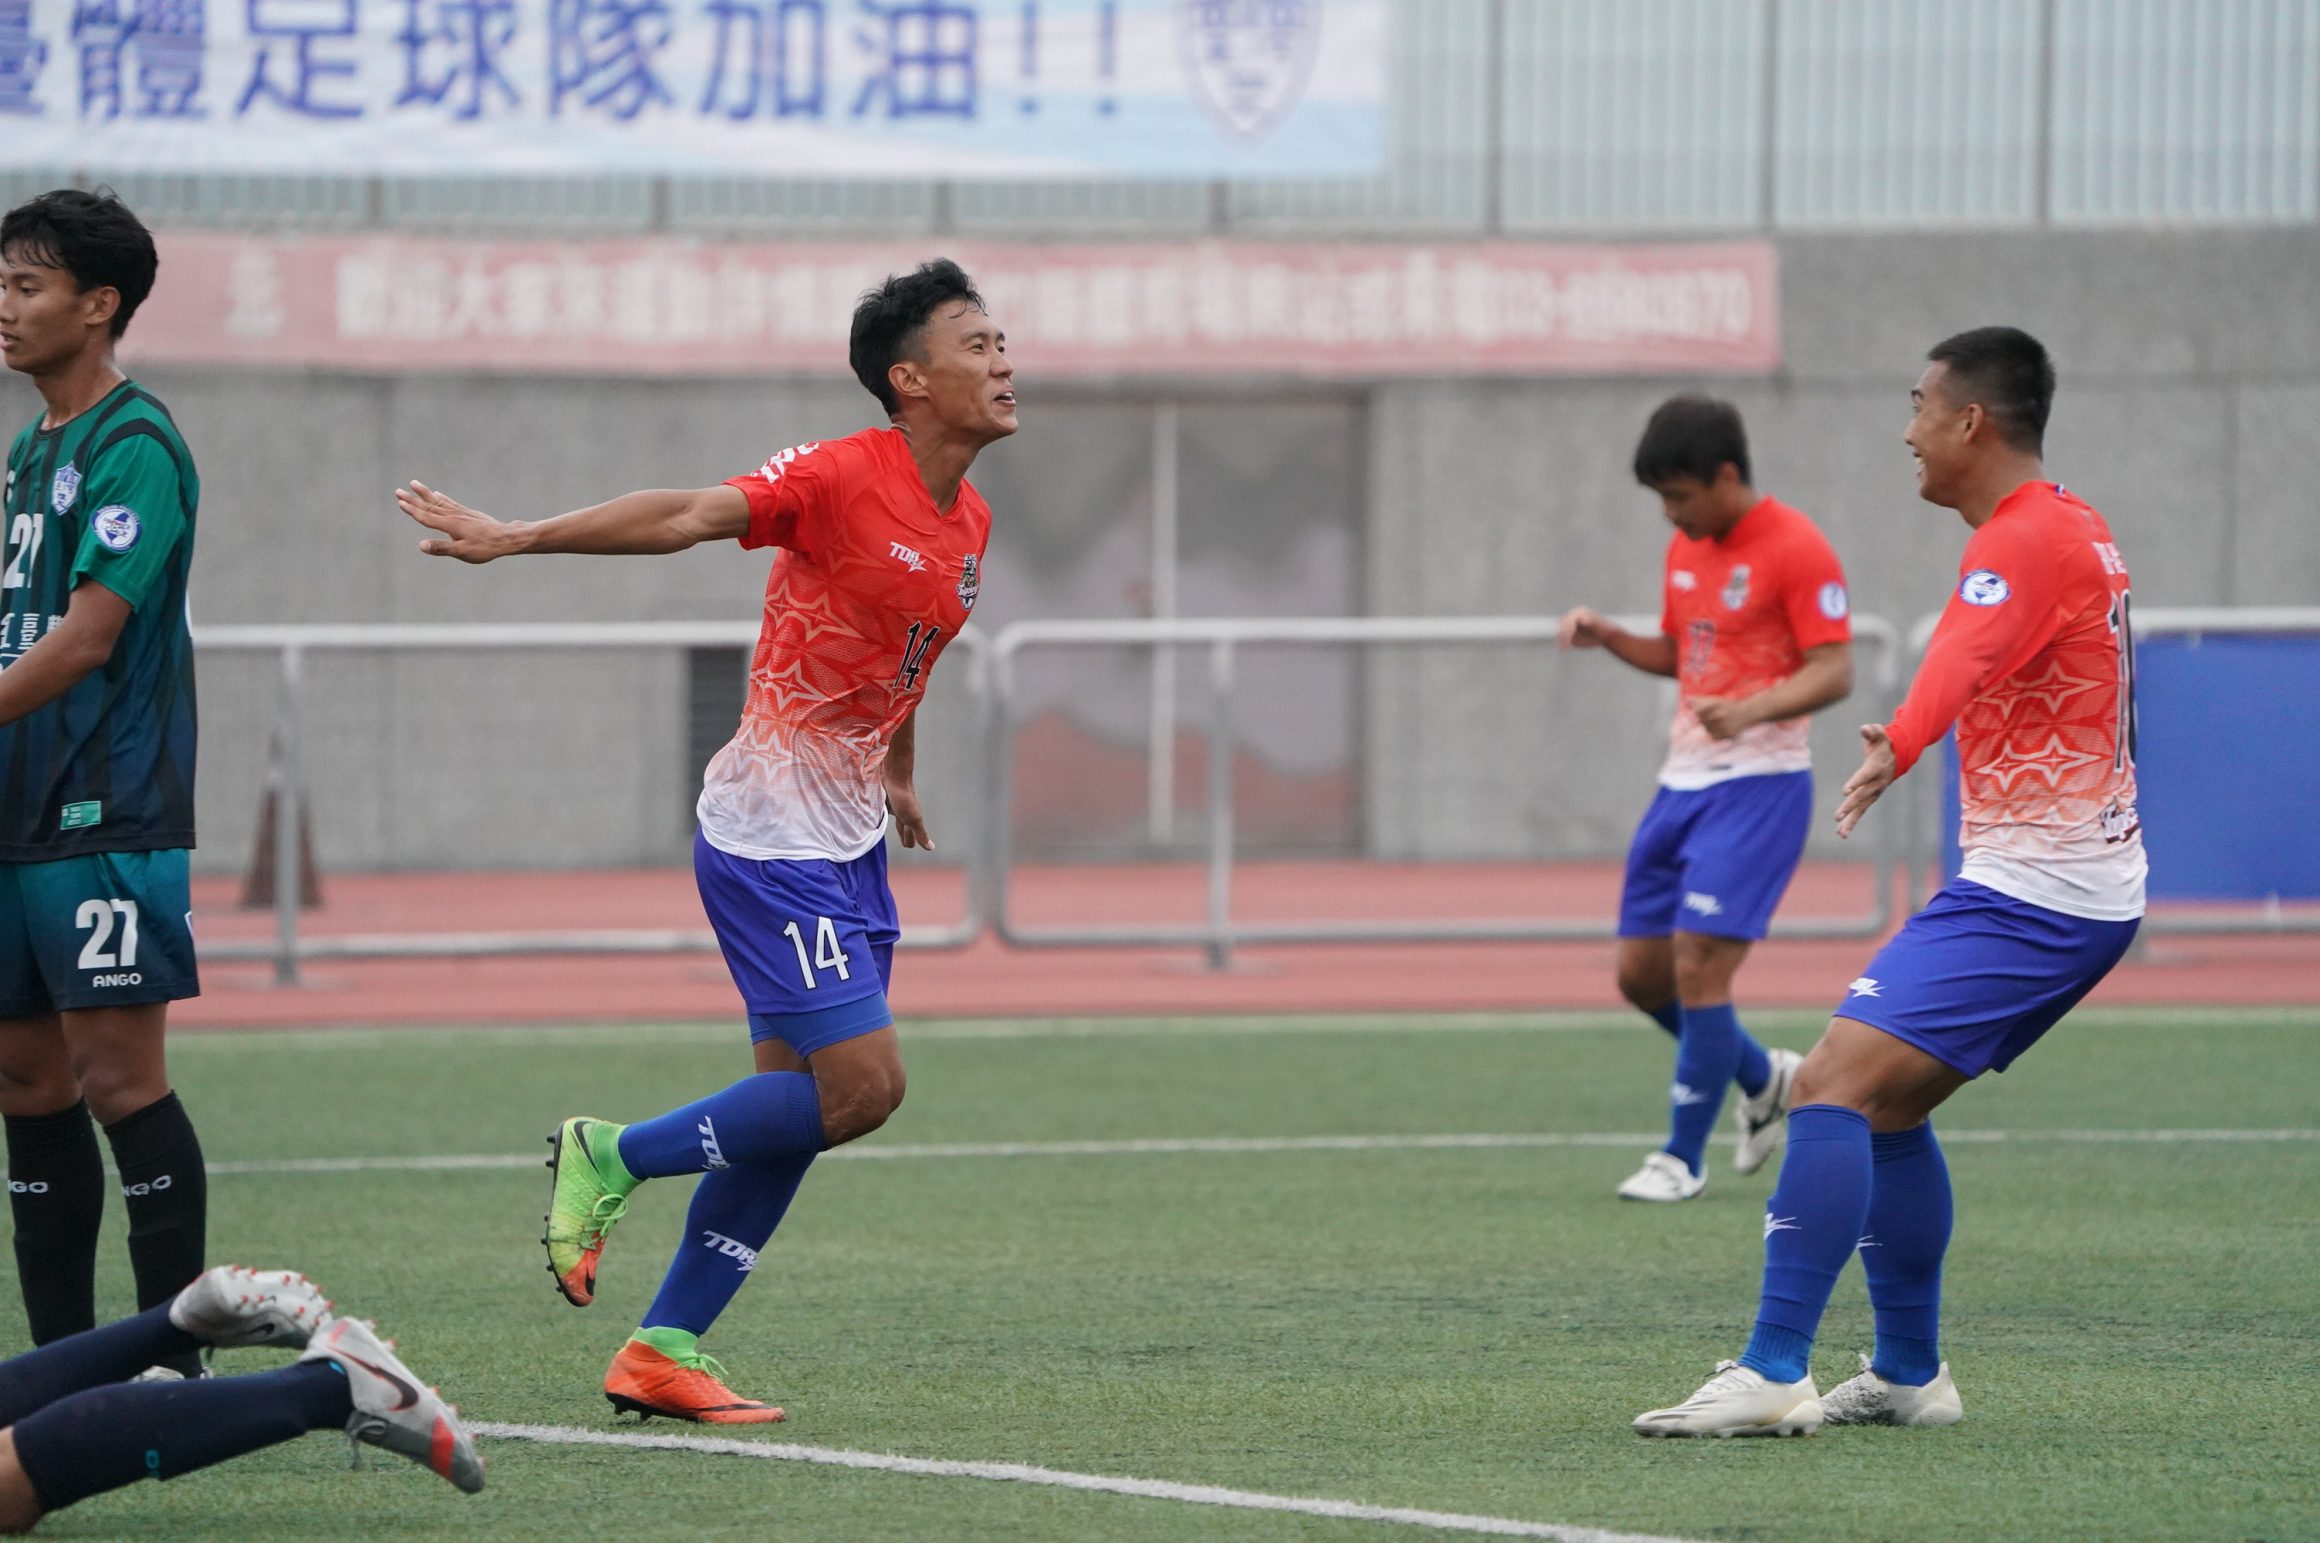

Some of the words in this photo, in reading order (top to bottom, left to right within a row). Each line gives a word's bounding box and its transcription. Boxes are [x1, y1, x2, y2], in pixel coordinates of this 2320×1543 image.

[893, 620, 940, 690] 14
[92, 972, 142, 988] ANGO
[783, 916, 850, 990] 14
